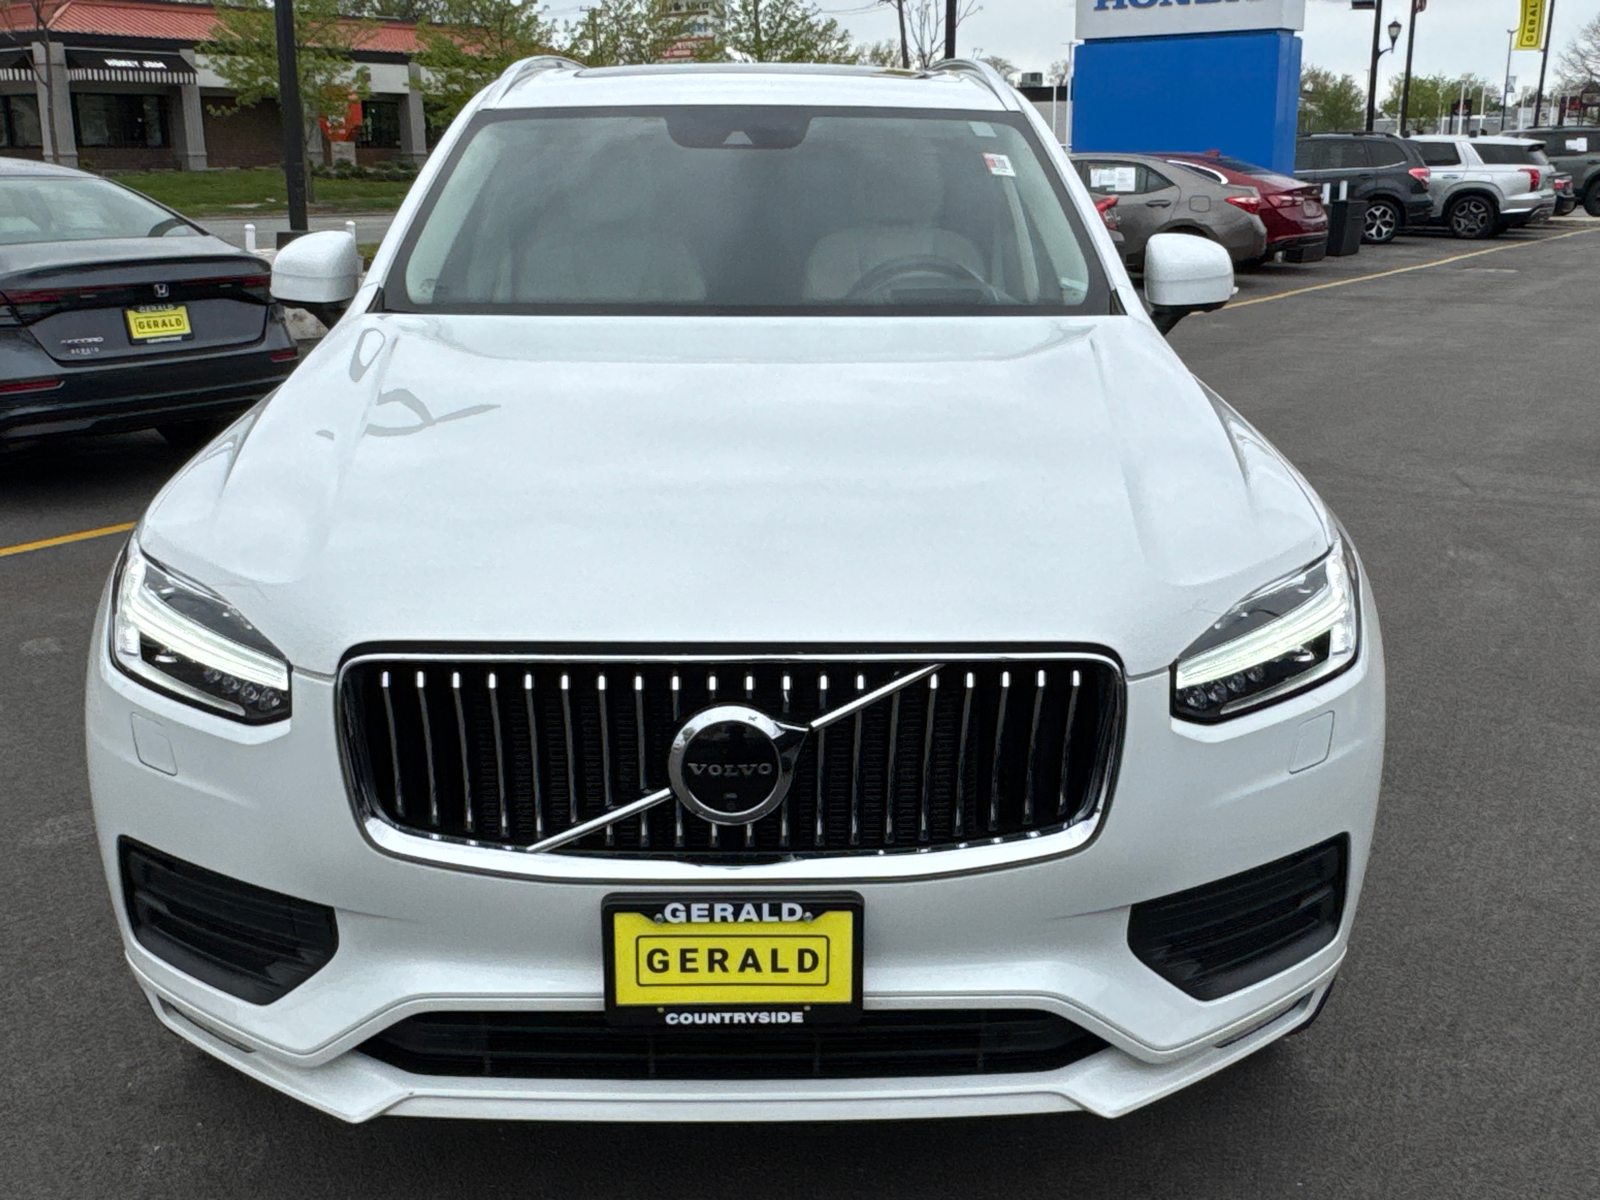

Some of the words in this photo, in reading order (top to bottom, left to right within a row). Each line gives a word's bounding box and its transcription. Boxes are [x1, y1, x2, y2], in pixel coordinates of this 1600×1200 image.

[1525, 0, 1538, 42] GERAL
[138, 318, 182, 330] GERALD
[687, 762, 773, 776] VOLVO
[664, 903, 803, 924] GERALD
[646, 948, 820, 974] GERALD
[665, 1012, 804, 1025] COUNTRYSIDE
